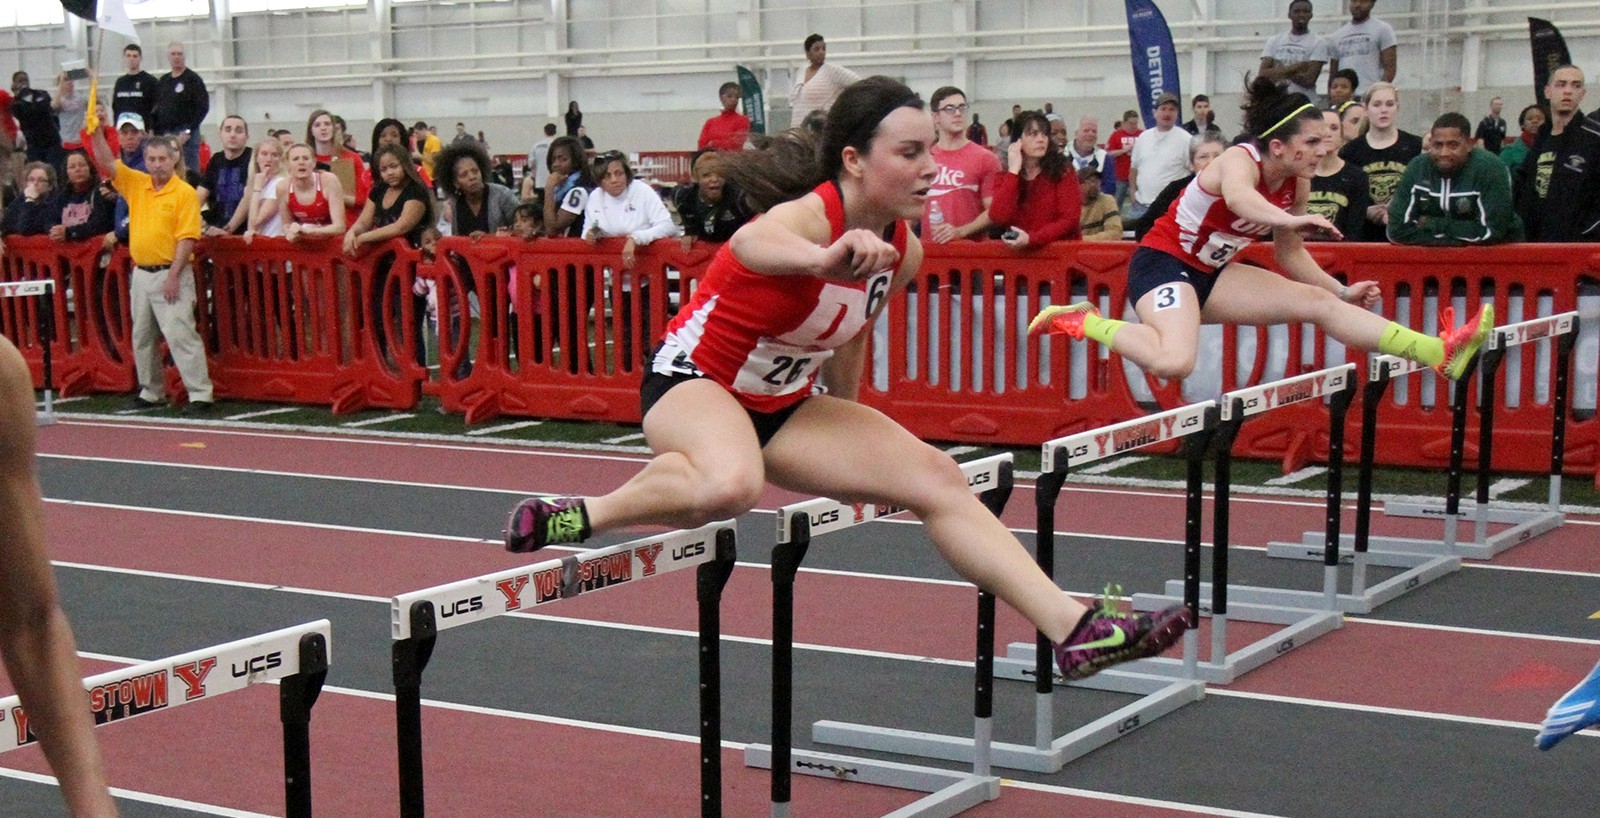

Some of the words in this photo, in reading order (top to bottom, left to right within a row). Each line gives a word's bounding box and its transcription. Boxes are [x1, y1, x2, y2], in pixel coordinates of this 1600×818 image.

[1146, 45, 1165, 105] DETRO
[930, 165, 965, 187] ke
[568, 189, 582, 208] 6
[865, 276, 888, 319] 6
[1157, 287, 1175, 308] 3
[762, 356, 811, 385] 26
[1095, 432, 1110, 457] Y
[1163, 415, 1177, 437] Y
[1181, 415, 1198, 428] UCS
[811, 509, 839, 526] UCS
[968, 472, 990, 486] UCS
[441, 596, 483, 618] UCS
[496, 574, 529, 611] Y
[635, 542, 663, 576] Y
[672, 541, 705, 561] UCS
[173, 656, 217, 701] Y
[232, 652, 282, 678] UCS
[1118, 715, 1140, 734] UCS
